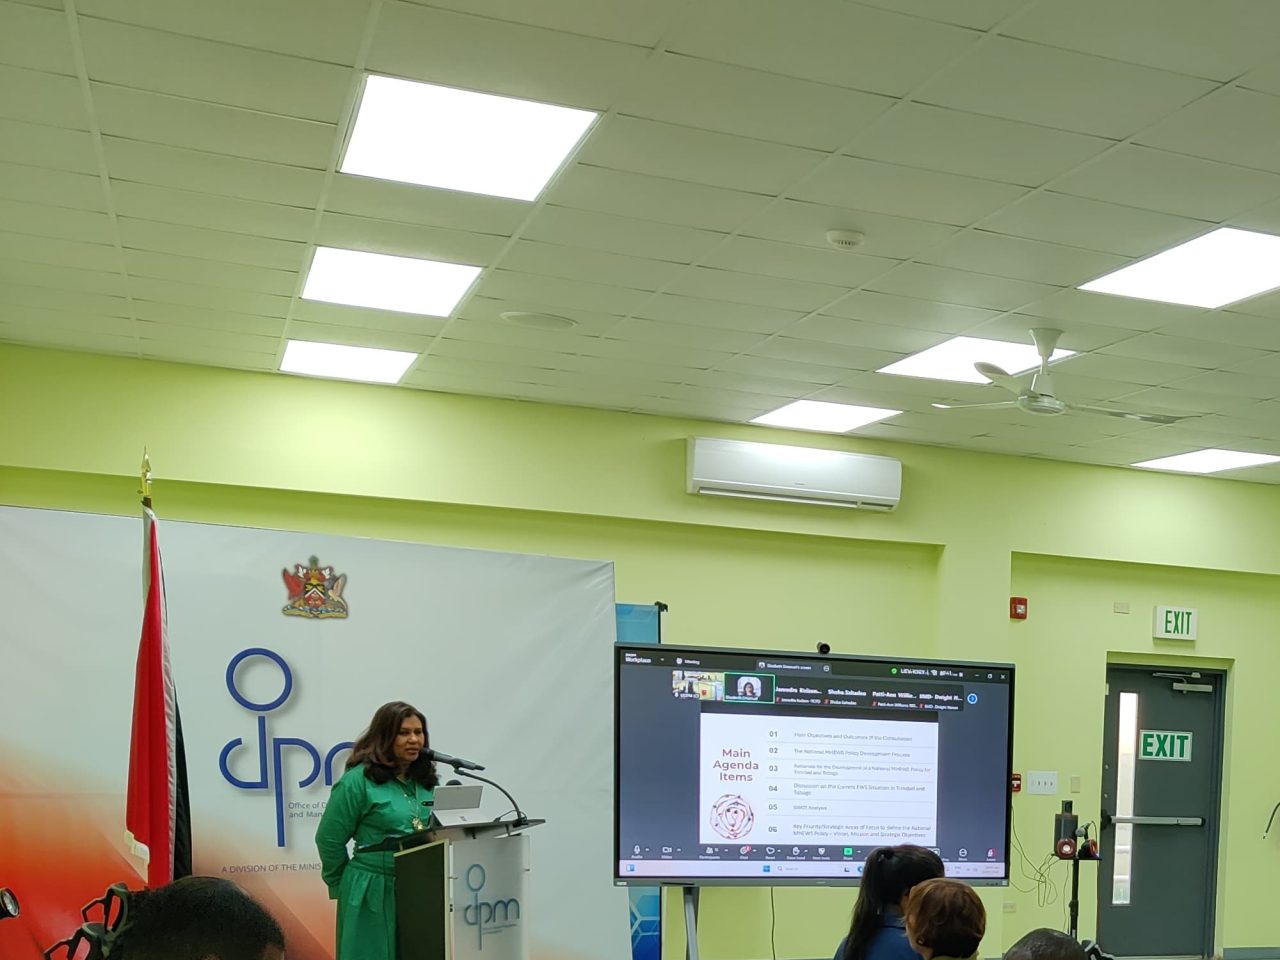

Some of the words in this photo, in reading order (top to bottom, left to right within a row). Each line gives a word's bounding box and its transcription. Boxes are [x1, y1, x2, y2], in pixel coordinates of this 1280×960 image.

[1165, 610, 1192, 635] EXIT
[1142, 733, 1189, 758] EXIT
[722, 748, 750, 758] Main
[713, 760, 759, 771] Agenda
[720, 772, 752, 782] Items
[230, 865, 266, 873] DIVISION
[268, 864, 279, 872] OF
[281, 863, 296, 871] THE
[299, 862, 321, 871] MINIS
